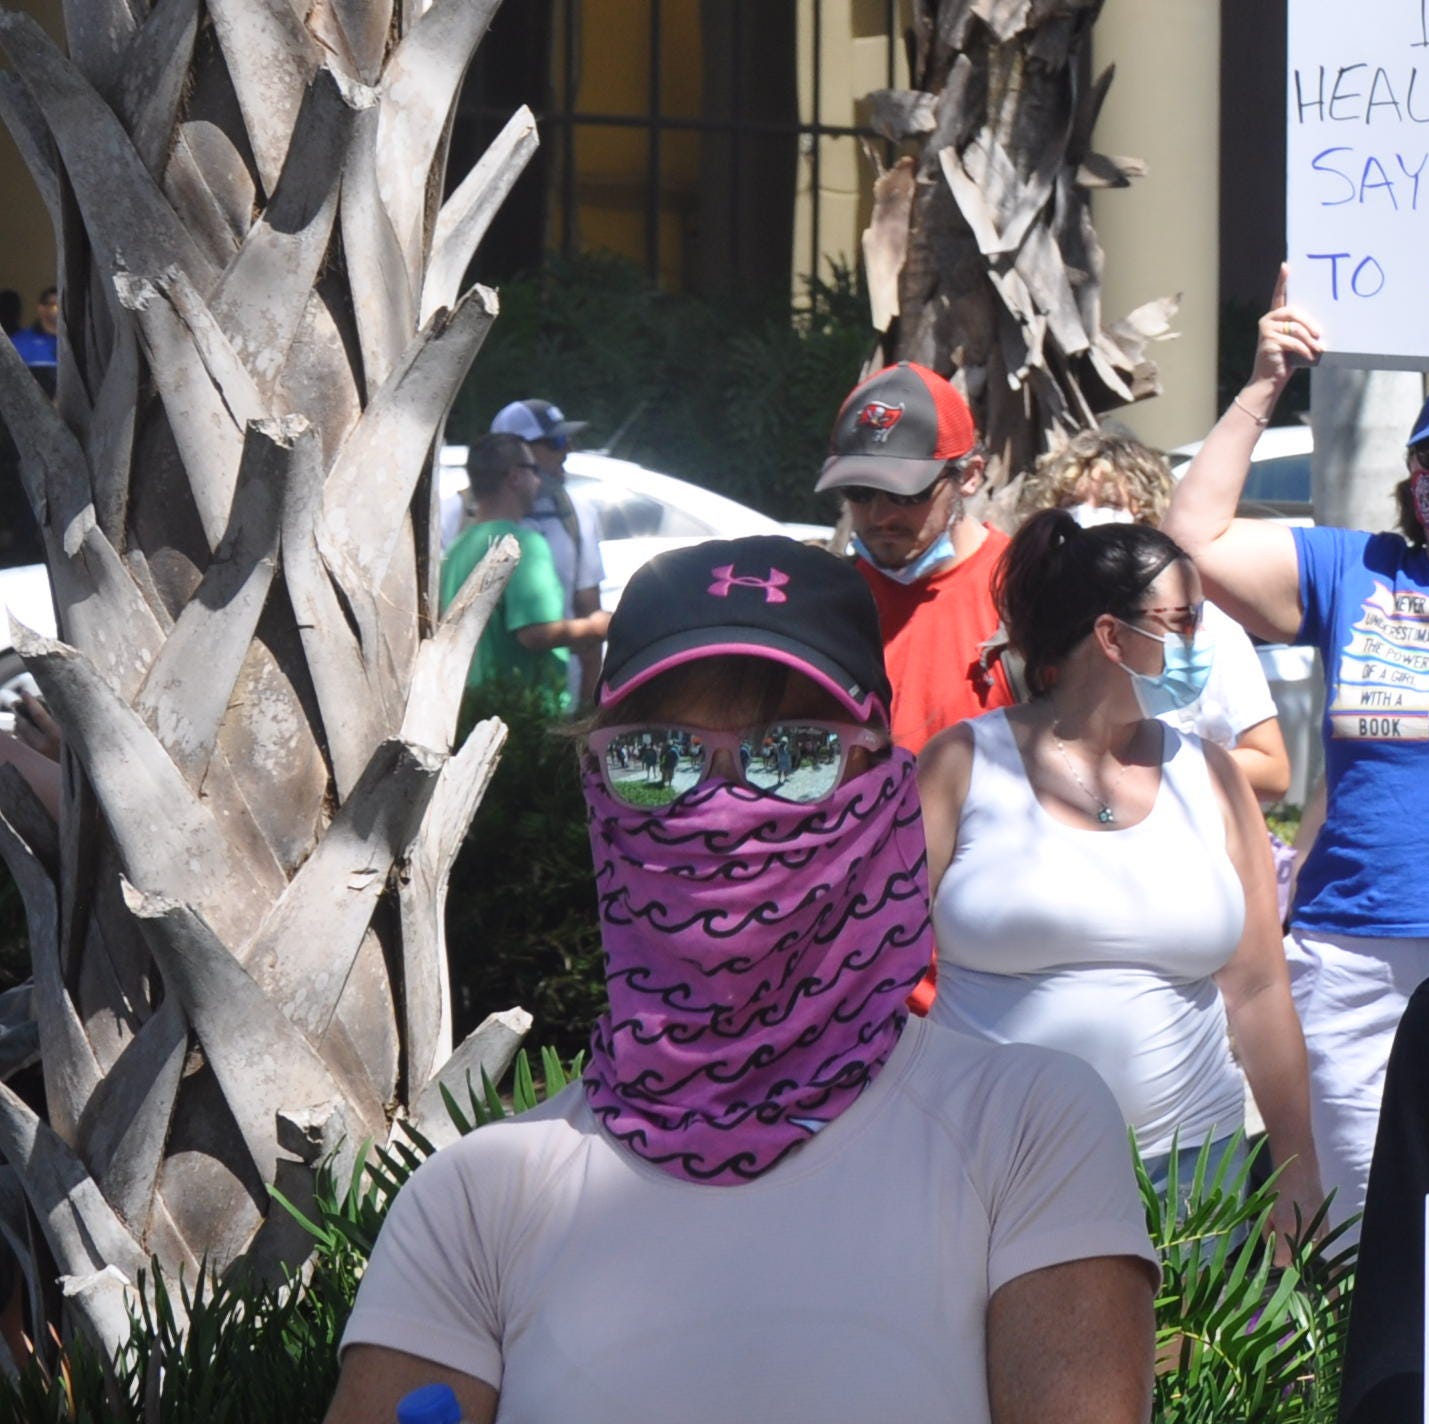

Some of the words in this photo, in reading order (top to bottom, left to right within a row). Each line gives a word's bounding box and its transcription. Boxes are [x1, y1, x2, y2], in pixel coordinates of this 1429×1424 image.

[1311, 147, 1429, 210] SAY
[1306, 253, 1386, 300] TO
[1364, 638, 1381, 654] THE
[1386, 648, 1429, 669] POWER
[1362, 665, 1375, 680] OF
[1377, 668, 1387, 680] A
[1360, 691, 1391, 706] WITH
[1395, 693, 1403, 706] A
[1359, 718, 1401, 737] BOOK
